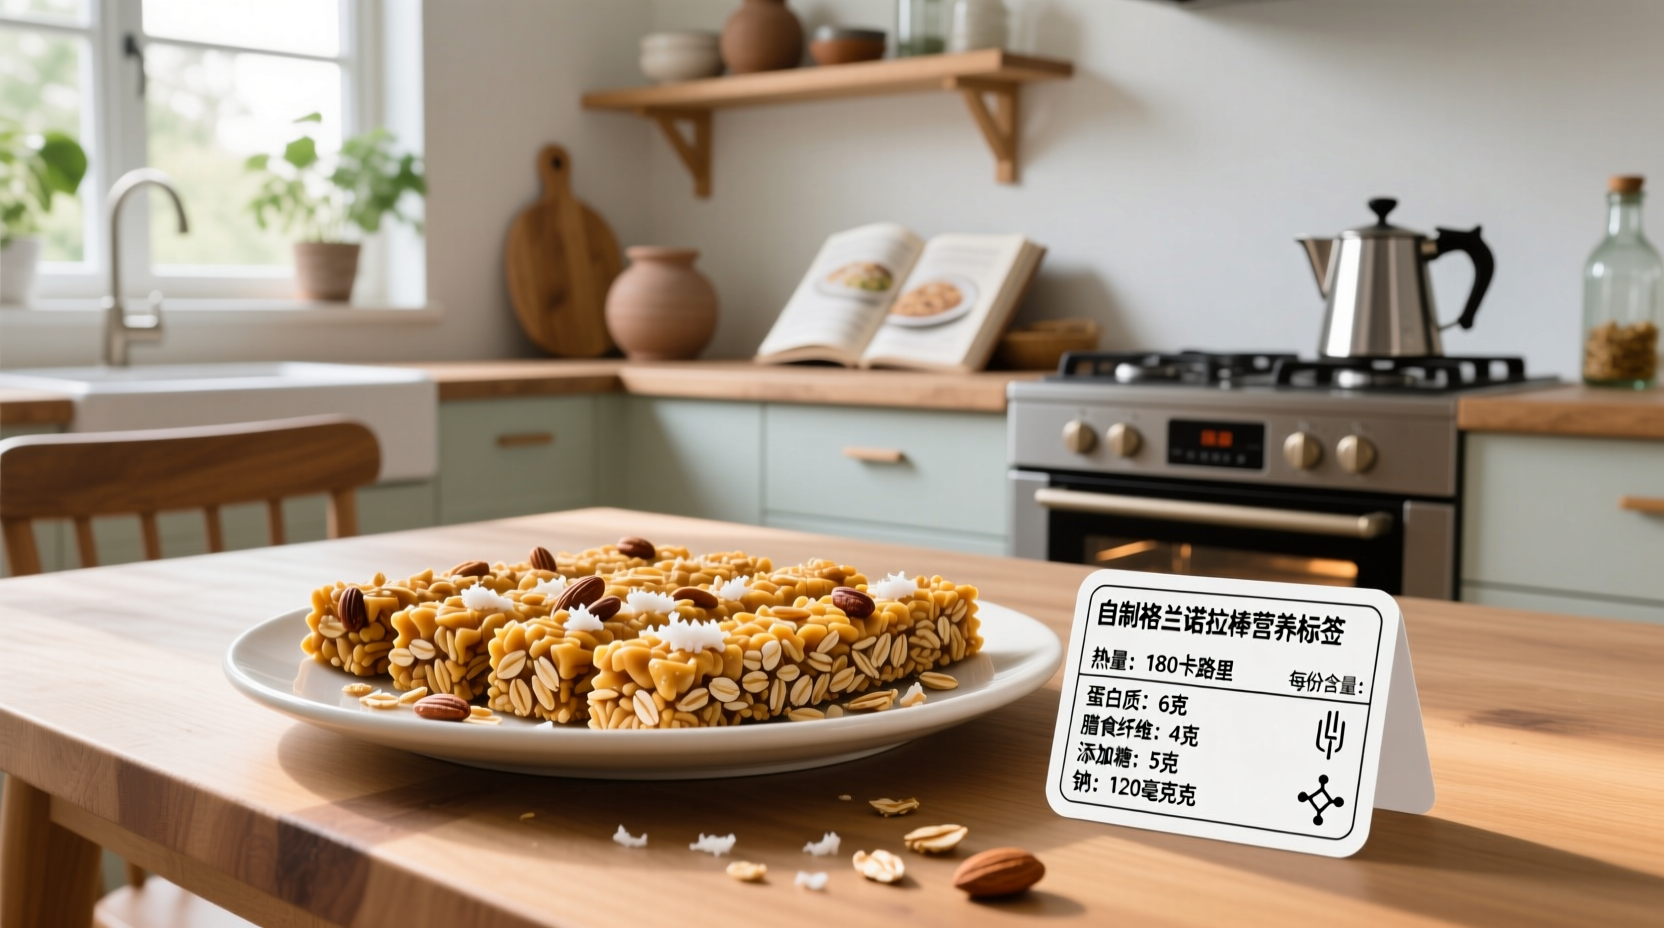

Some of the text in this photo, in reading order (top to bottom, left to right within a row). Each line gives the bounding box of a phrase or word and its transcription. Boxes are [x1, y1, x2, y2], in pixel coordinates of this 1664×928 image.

[1098, 599, 1346, 645] 自制格兰诺拉棒营养标签
